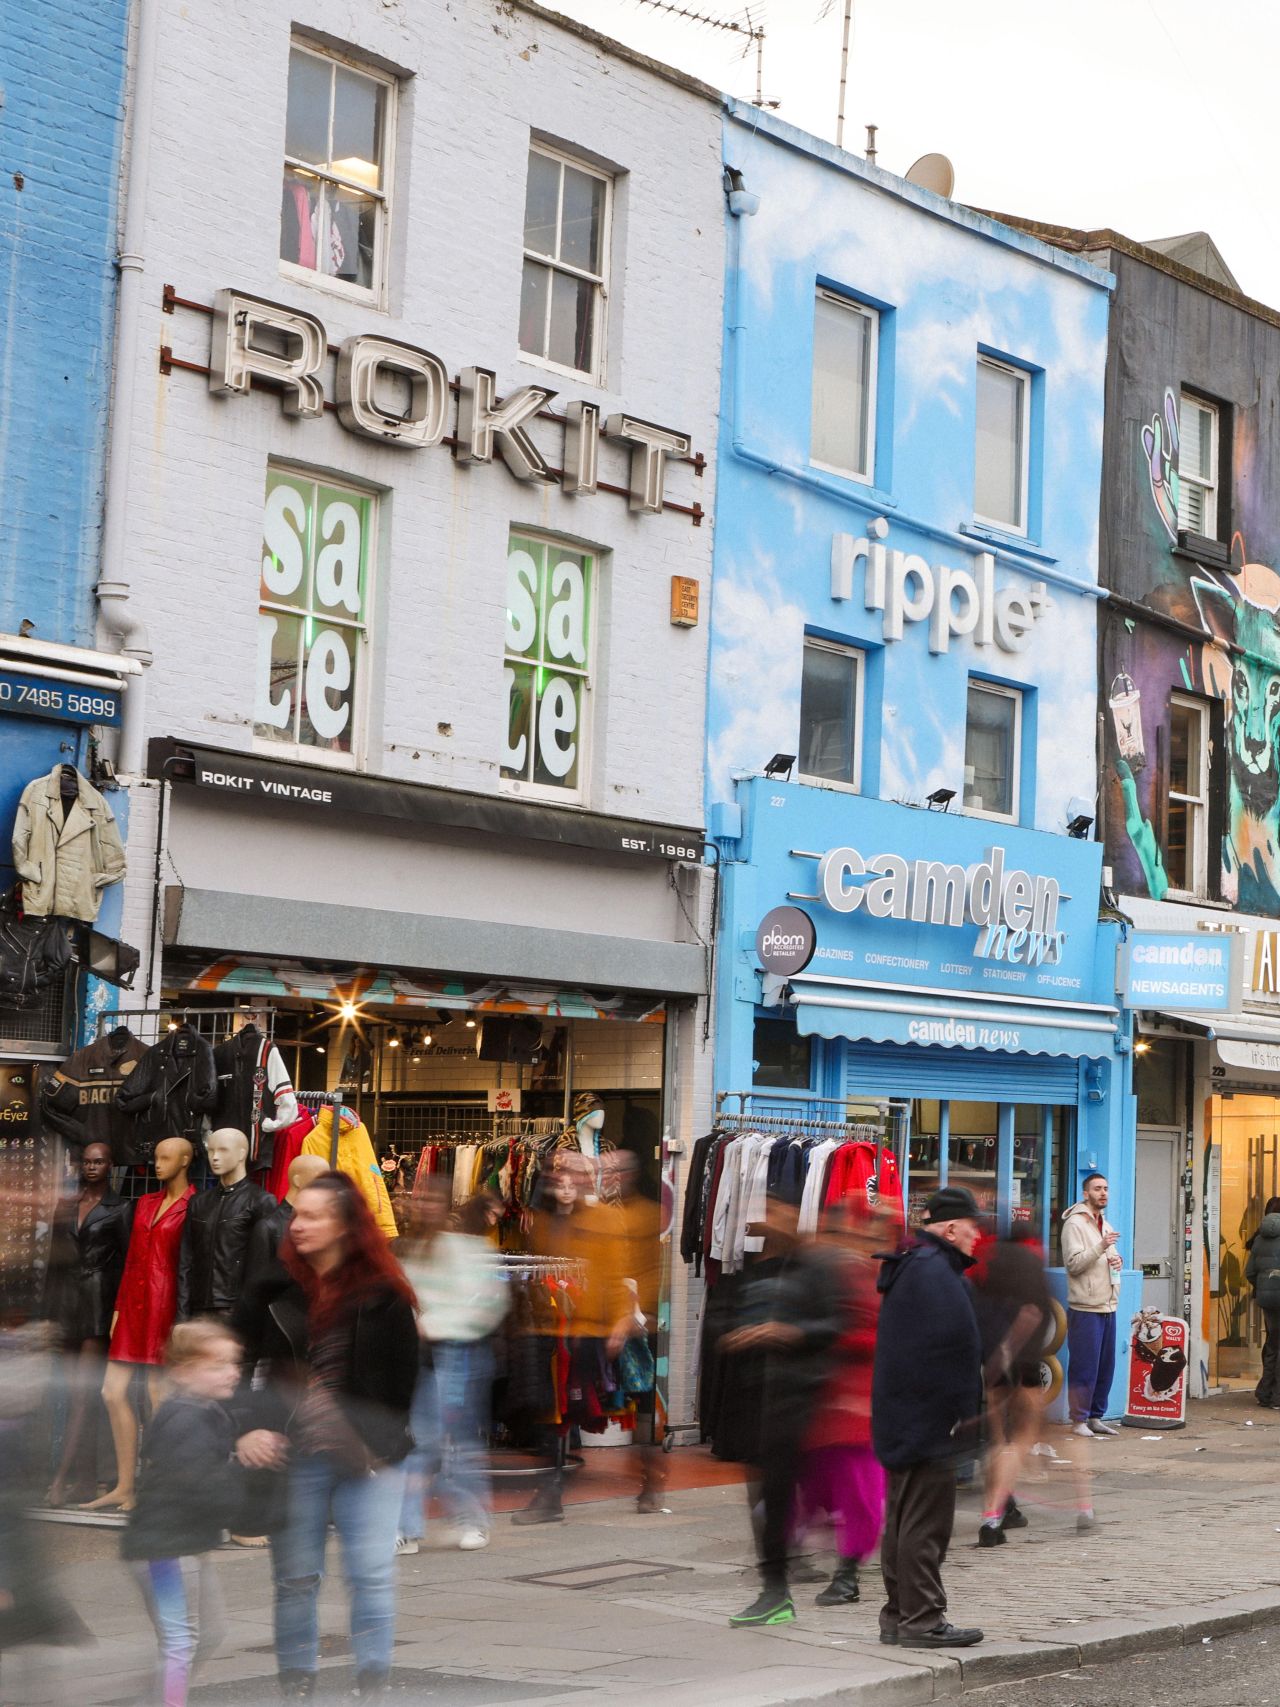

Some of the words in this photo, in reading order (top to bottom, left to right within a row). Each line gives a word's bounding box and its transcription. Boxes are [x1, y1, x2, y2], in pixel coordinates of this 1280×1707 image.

[208, 287, 692, 515] ROKIT
[15, 685, 63, 709] 7485
[67, 694, 116, 718] 5899
[201, 770, 254, 790] ROKIT
[260, 780, 333, 803] VINTAGE
[769, 795, 786, 808] 227
[621, 838, 651, 852] EST.
[659, 843, 697, 859] 1986
[816, 846, 1061, 935] camden
[762, 925, 805, 957] ploom
[973, 922, 1068, 967] news
[1131, 942, 1223, 966] camden
[814, 946, 854, 962] AGAZINES
[864, 952, 931, 971] CONFECTIONERY
[940, 962, 973, 976] LOTTERY
[982, 967, 1027, 982] STATIONERY
[1036, 974, 1081, 989] OFF-LICENCE
[1131, 979, 1225, 998] NEWSAGENTS
[908, 1018, 976, 1044] camden
[978, 1028, 1020, 1047] news
